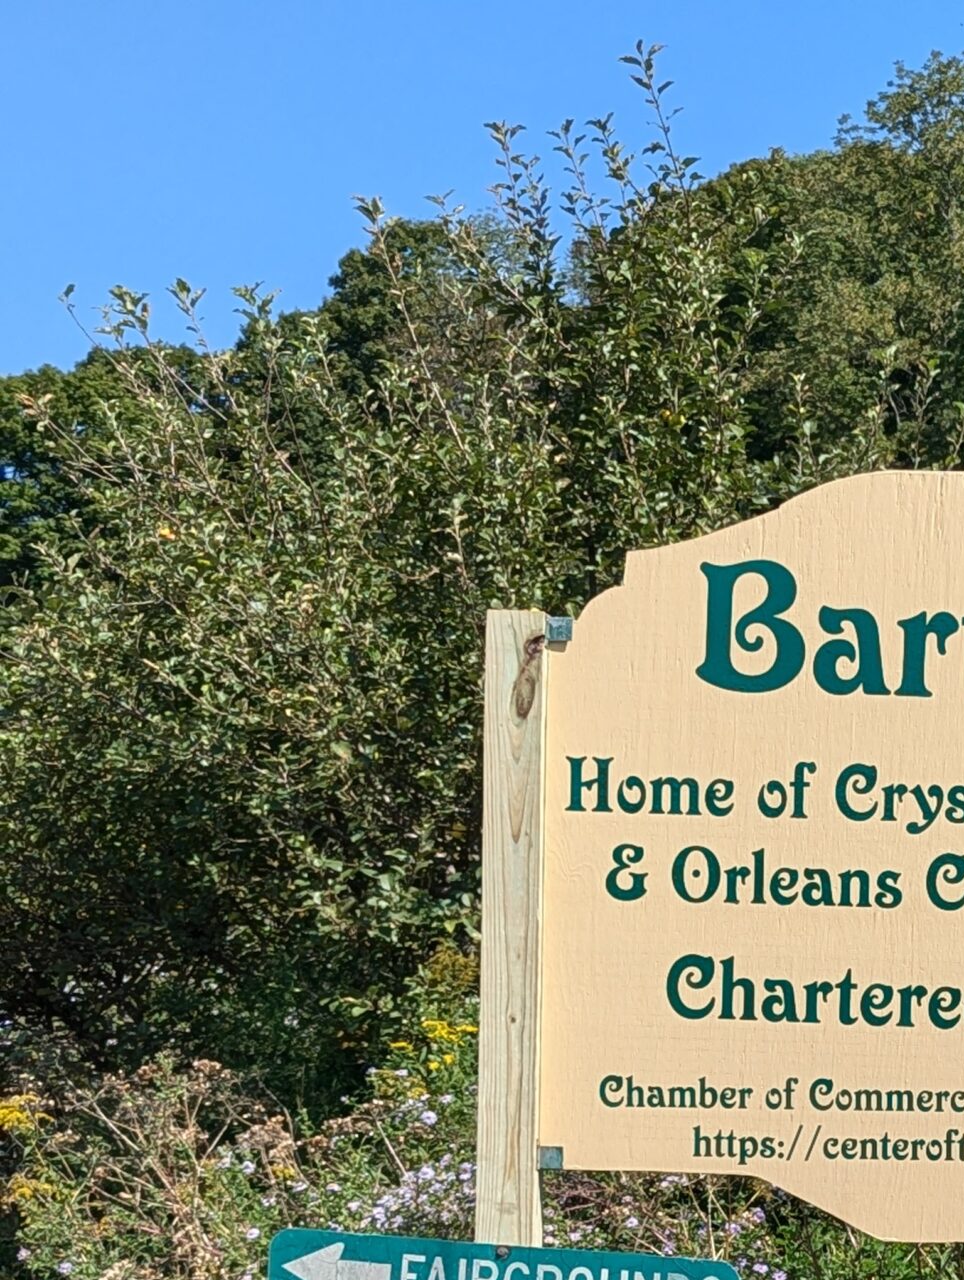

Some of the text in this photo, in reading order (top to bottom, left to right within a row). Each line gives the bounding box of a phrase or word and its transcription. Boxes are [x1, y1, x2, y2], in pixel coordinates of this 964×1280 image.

[566, 757, 734, 816] Home
[758, 762, 816, 818] of
[606, 844, 648, 901] &
[672, 846, 902, 908] Orleans
[600, 1075, 753, 1108] Chamber
[766, 1078, 798, 1109] of
